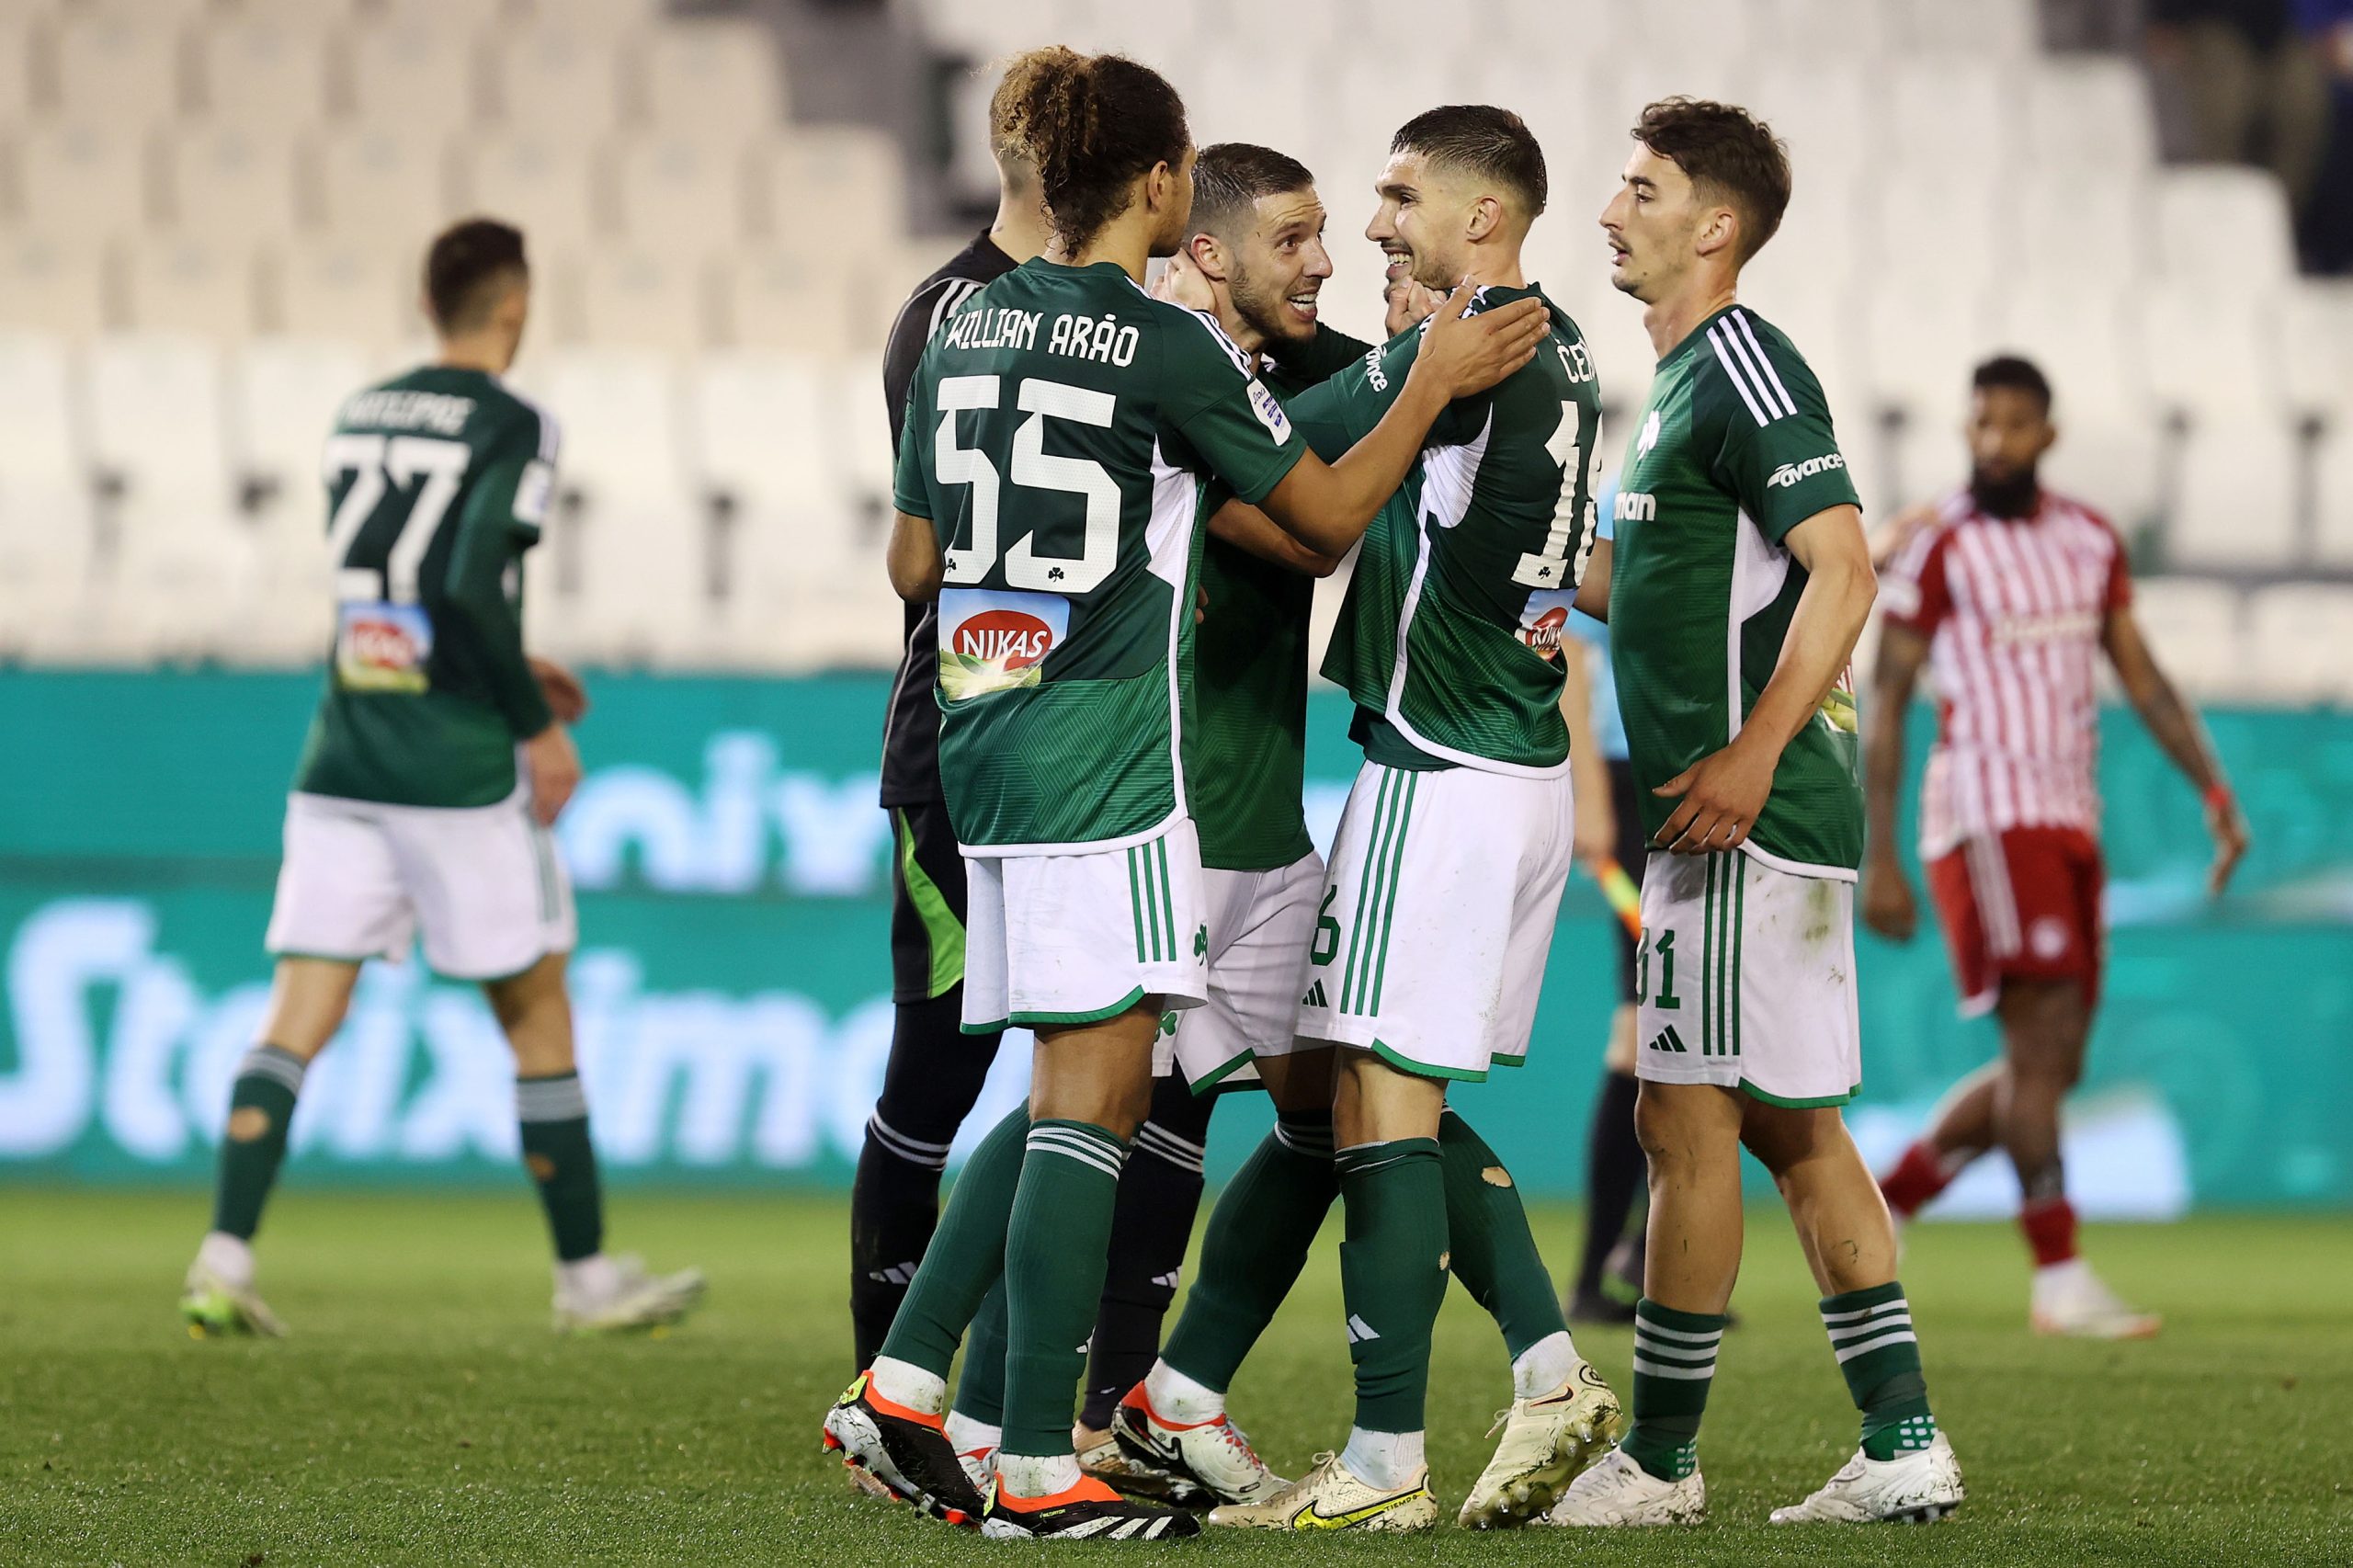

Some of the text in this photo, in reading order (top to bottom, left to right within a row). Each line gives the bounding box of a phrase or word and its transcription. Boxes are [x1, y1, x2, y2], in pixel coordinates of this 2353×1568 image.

[944, 308, 1140, 368] WILLIAN ARÃO
[935, 375, 1122, 594] 55
[1778, 452, 1844, 488] avance
[962, 629, 1048, 660] NIKAS
